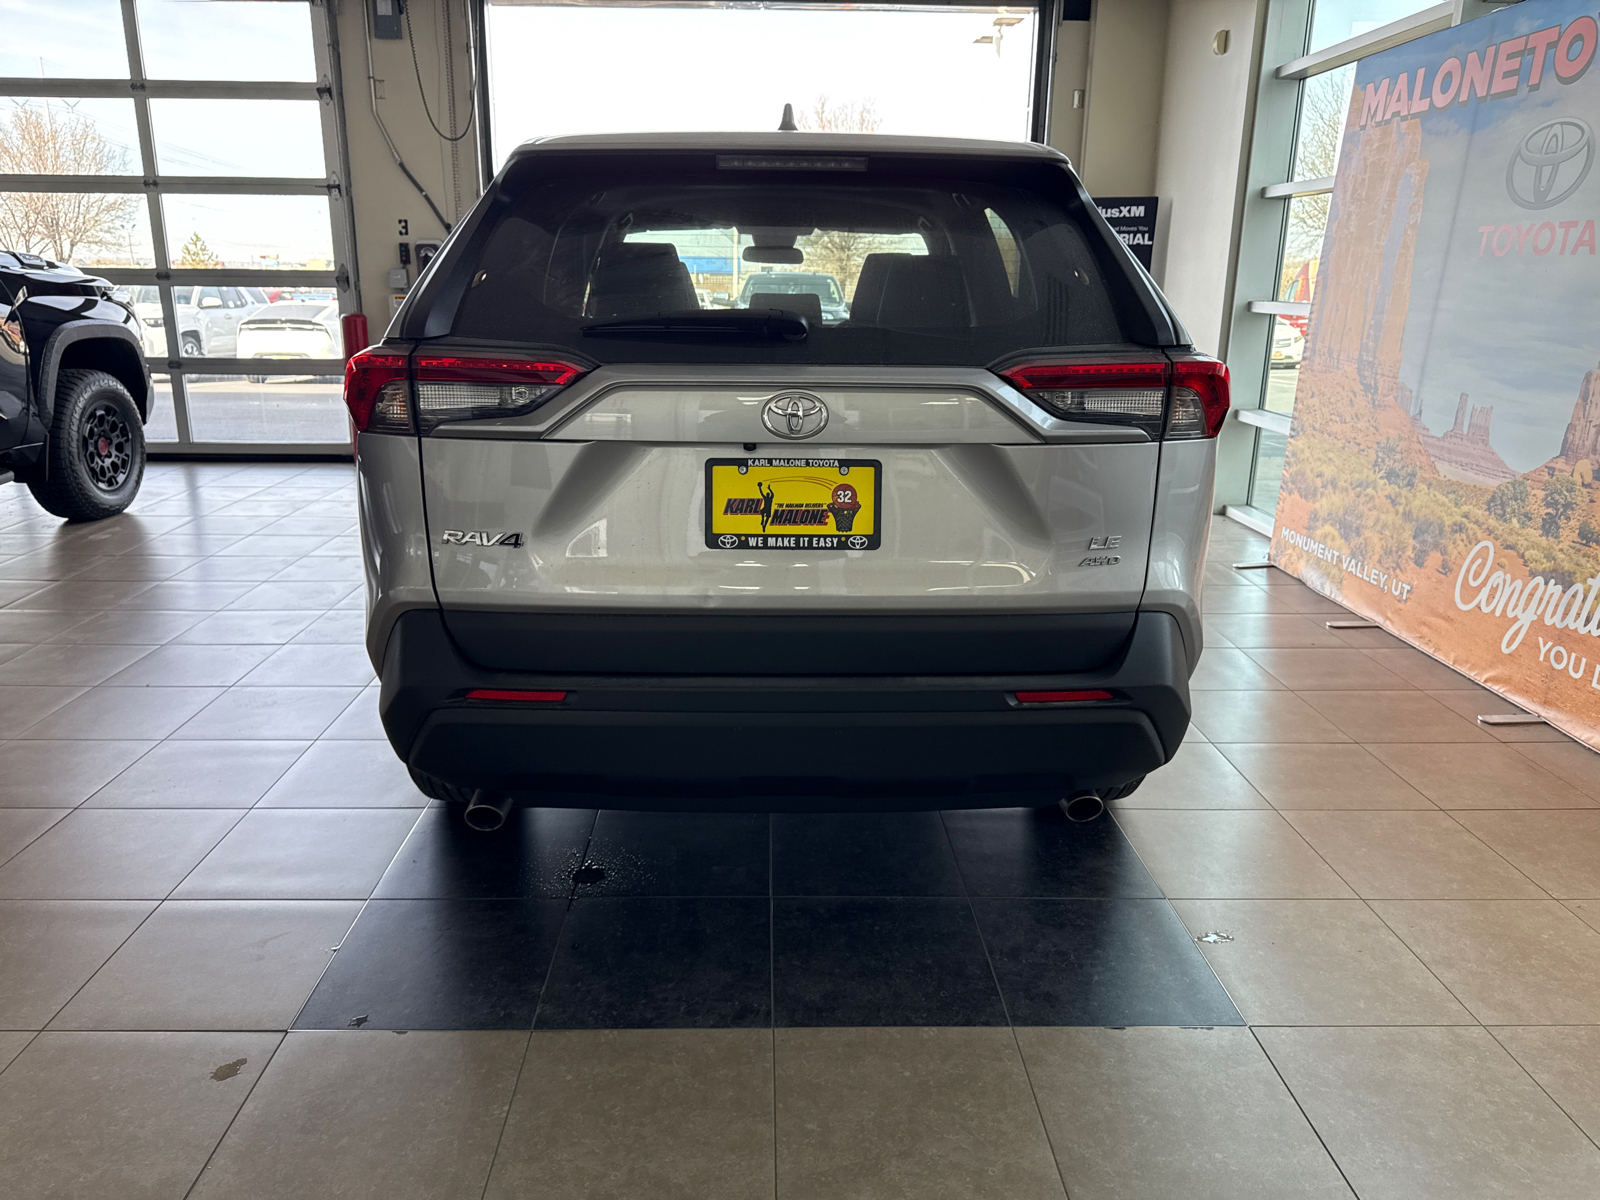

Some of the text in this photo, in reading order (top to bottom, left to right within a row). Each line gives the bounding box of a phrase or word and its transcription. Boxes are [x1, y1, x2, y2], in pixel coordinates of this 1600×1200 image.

[1358, 15, 1600, 131] MALONETO
[1098, 205, 1145, 217] iusXM
[398, 219, 409, 235] 3
[1117, 233, 1153, 245] RIAL
[1478, 219, 1597, 257] TOYOTA
[748, 459, 839, 468] KARL MALONE TOYOTA
[837, 490, 852, 503] 32
[723, 498, 763, 515] KARL
[769, 509, 830, 526] MALONE
[442, 529, 524, 549] RAV4
[748, 536, 838, 548] WE MAKE IT EASY
[1088, 535, 1122, 550] LE
[1078, 555, 1121, 567] AWD
[1280, 526, 1412, 600] MONUMENT VALLEY, UT
[1455, 540, 1600, 654] Congrat
[1538, 636, 1586, 679] YOU
